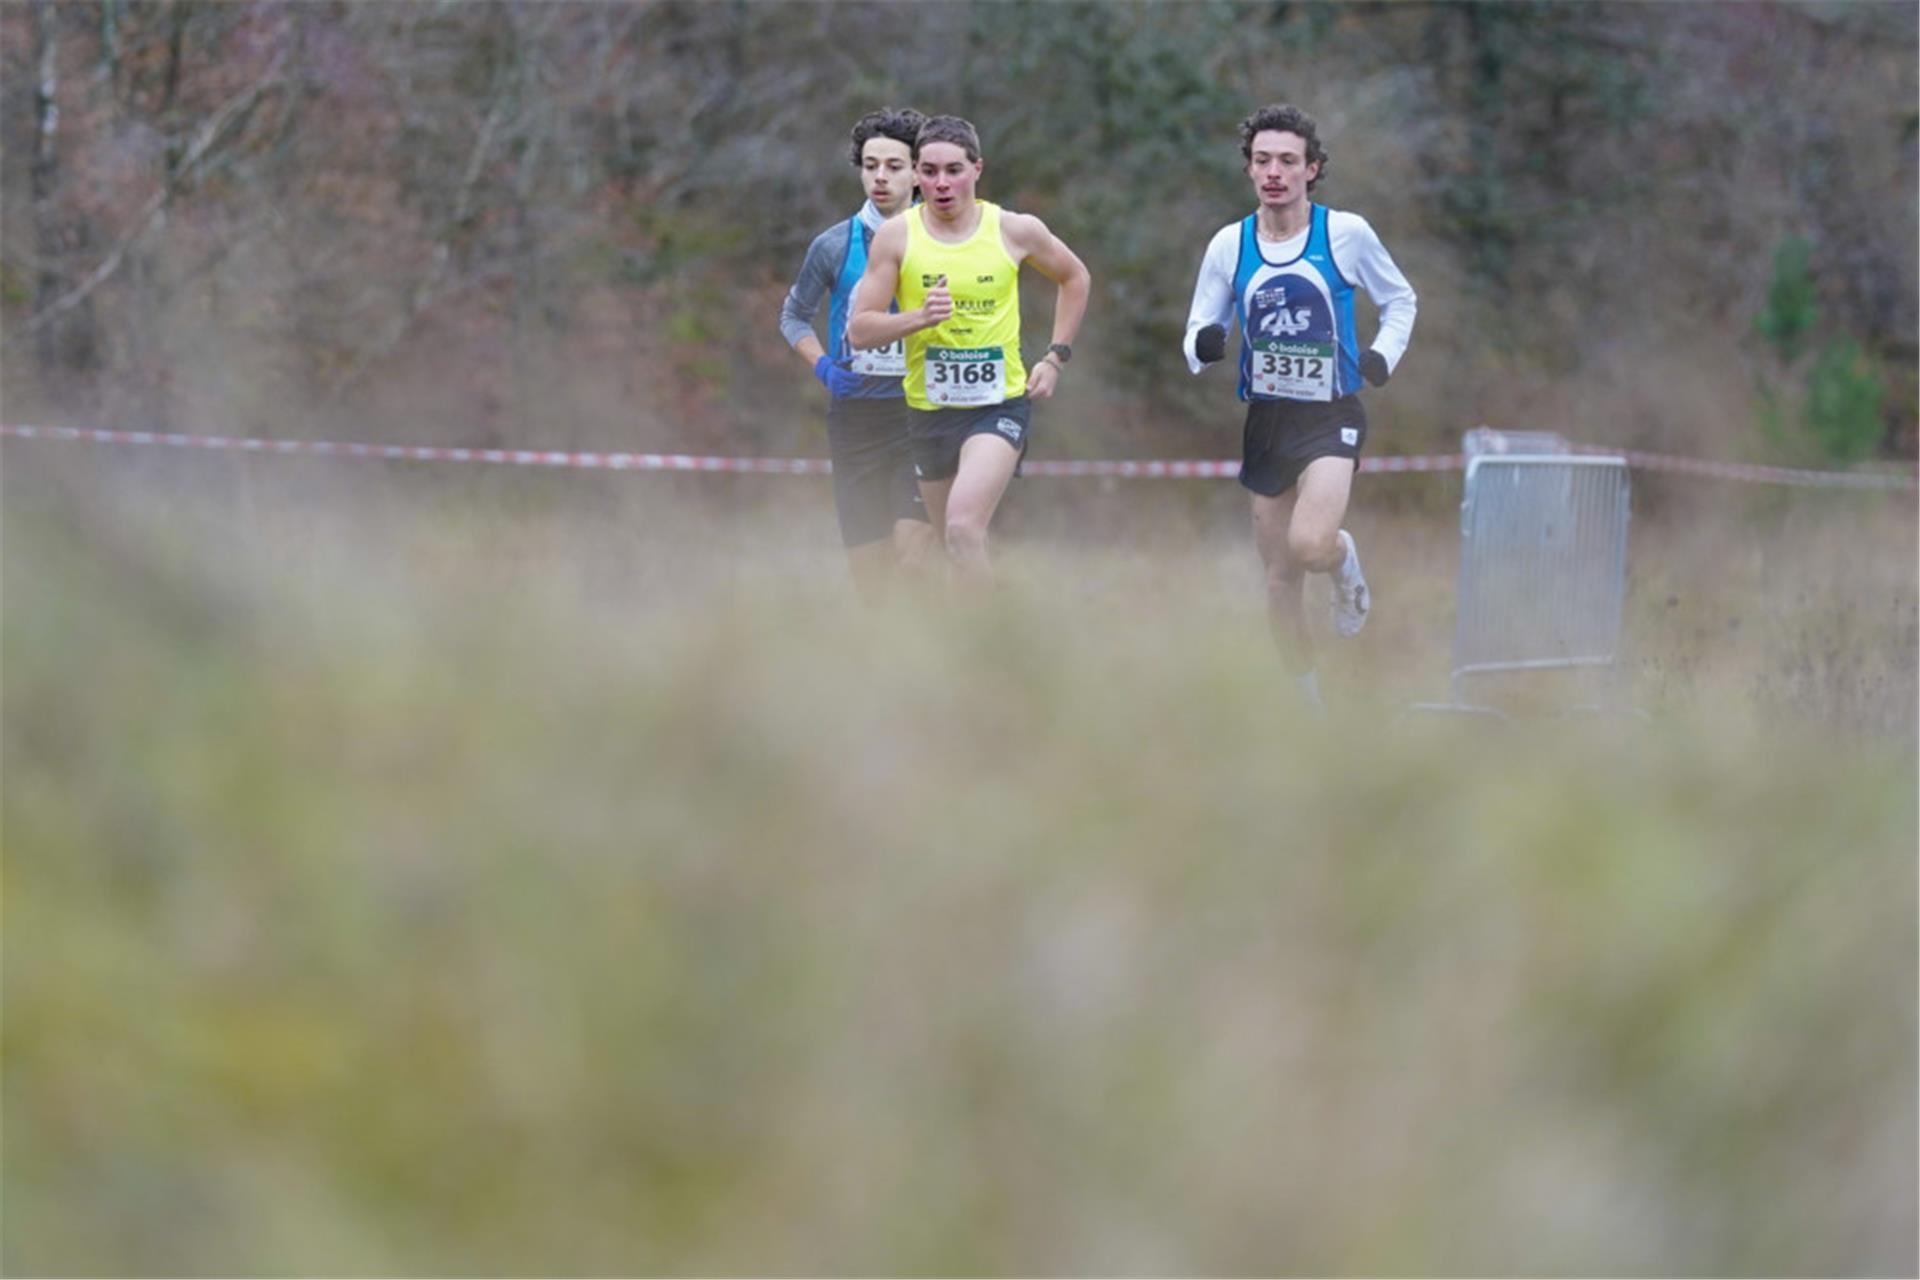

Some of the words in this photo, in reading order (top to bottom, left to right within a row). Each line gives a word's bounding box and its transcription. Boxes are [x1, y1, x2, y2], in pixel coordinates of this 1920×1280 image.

[949, 349, 990, 360] baloise
[1279, 342, 1319, 355] baloise
[933, 362, 997, 385] 3168
[1261, 353, 1324, 380] 3312
